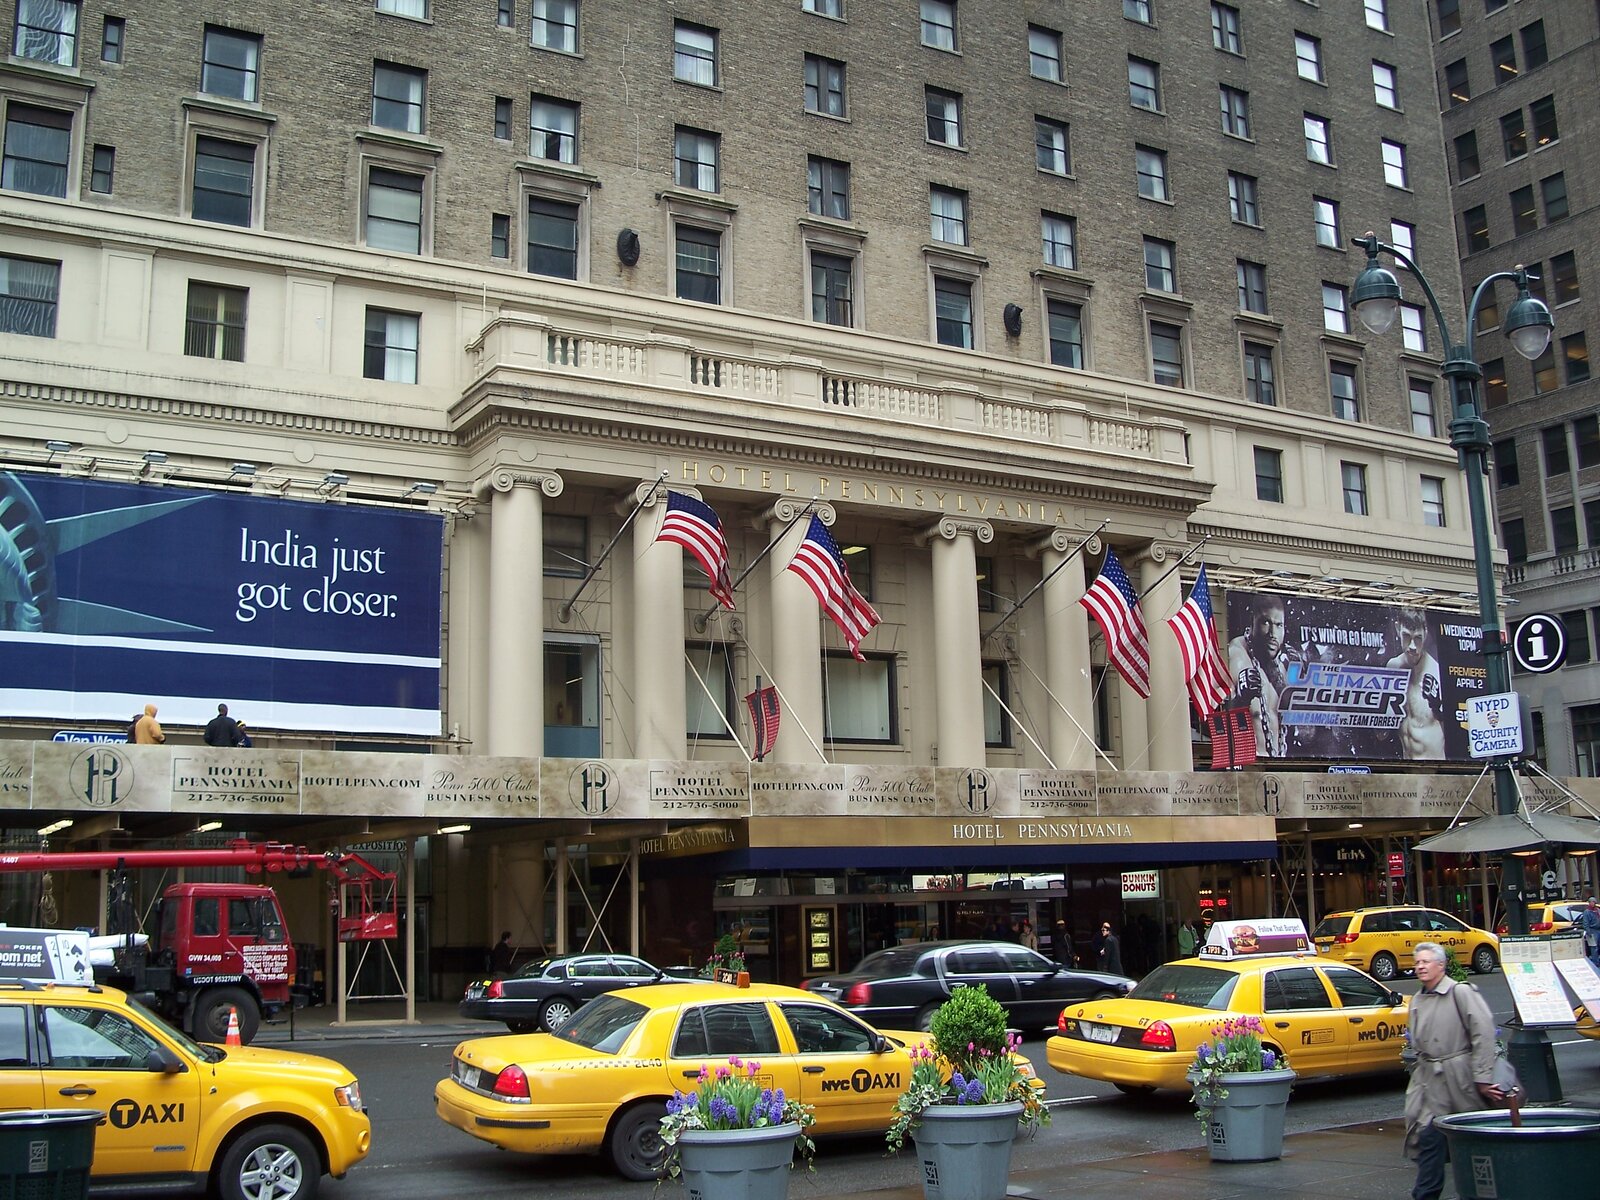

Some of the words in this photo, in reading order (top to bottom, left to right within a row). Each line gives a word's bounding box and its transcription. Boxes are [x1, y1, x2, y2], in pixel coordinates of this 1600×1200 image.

[682, 460, 798, 494] HOTEL
[819, 475, 1070, 525] PENNSYLVANIA
[240, 527, 317, 569] India
[330, 537, 386, 583] just
[235, 579, 292, 622] got
[303, 576, 398, 619] closer.
[1300, 626, 1317, 642] IT'S
[1319, 626, 1336, 645] WIN
[1337, 629, 1348, 646] OR
[1349, 630, 1360, 647] GO
[1458, 639, 1477, 652] 10PM
[1322, 664, 1340, 673] THE
[1287, 662, 1409, 692] ULTIMATE
[1456, 679, 1476, 689] APRIL
[1477, 679, 1484, 689] 2
[1278, 686, 1407, 716] FIGHTER
[1475, 698, 1510, 713] NYPD
[1304, 713, 1339, 725] RAMPAGE
[1349, 715, 1368, 727] TEAM
[1369, 716, 1401, 728] FORREST
[1471, 726, 1519, 742] SECURITY
[1474, 738, 1518, 753] CAMERA
[208, 766, 268, 778] HOTEL
[180, 777, 293, 789] PENNSYLVANIA
[304, 776, 421, 789] HOTELPENN.COM
[431, 770, 464, 790] Penn
[468, 777, 500, 790] 5000
[501, 771, 533, 791] Club
[677, 777, 724, 787] HOTEL
[752, 781, 844, 792] HOTELPENN.COM
[852, 775, 878, 793] Penn
[906, 775, 932, 793] Club
[1041, 780, 1078, 789] HOTEL
[655, 787, 745, 797] PENNSYLVANIA
[1024, 789, 1093, 797] PENNSYLVANIA
[1099, 786, 1170, 795] HOTELPENN.COM
[188, 793, 285, 804] 212-736-5000
[427, 793, 491, 802] BUSINESS
[497, 794, 538, 803] CLASS
[849, 794, 899, 804] BUSINESS
[903, 796, 935, 805] CLASS
[1306, 793, 1360, 801] PENNSYLVANIA
[663, 801, 739, 809] 212-736-5000
[953, 824, 1005, 839] HOTEL
[1018, 823, 1133, 838] PENNSYLVANIA
[640, 839, 665, 855] HOTEL
[667, 828, 735, 851] PENNSYLVANIA
[1337, 847, 1366, 861] Lindy's
[1122, 873, 1157, 883] DUNKIN'
[1123, 883, 1156, 892] DONUTS
[1258, 925, 1273, 933] Follow
[1273, 924, 1285, 932] That
[188, 954, 203, 962] GVW
[1358, 1031, 1376, 1041] NYC
[822, 1079, 851, 1092] NYC
[851, 1068, 900, 1093] TAXI
[109, 1098, 185, 1129] TAXI
